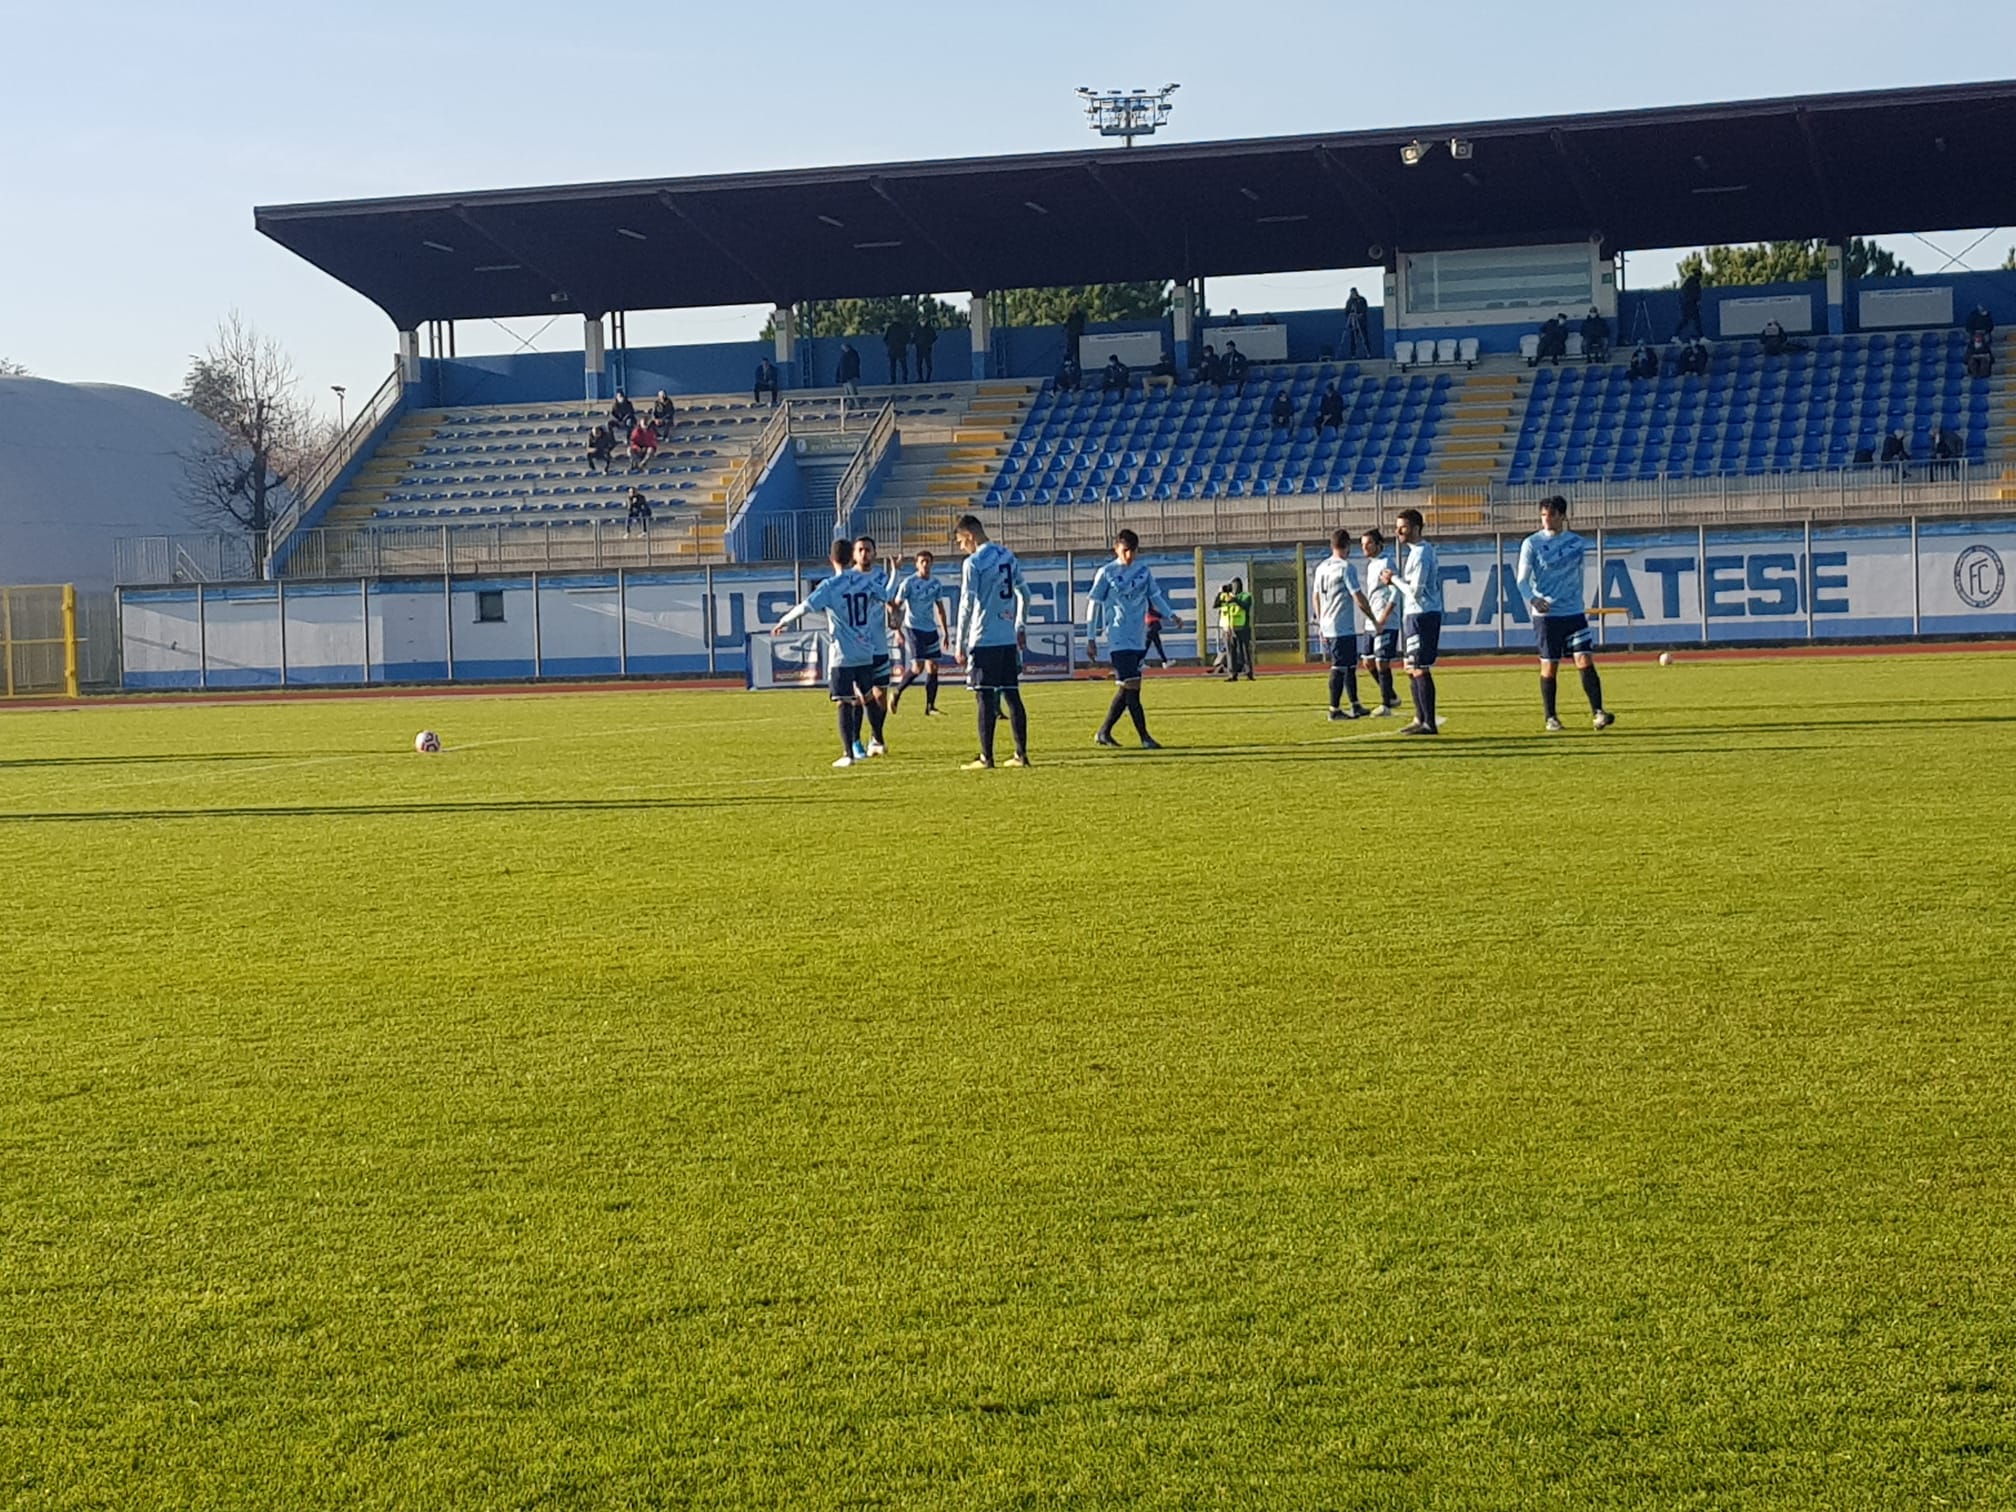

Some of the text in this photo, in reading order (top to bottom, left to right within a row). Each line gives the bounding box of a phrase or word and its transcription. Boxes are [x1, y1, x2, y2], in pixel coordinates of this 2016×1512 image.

[998, 562, 1013, 600] 3
[1436, 551, 1849, 626] CAATESE
[1969, 557, 1990, 597] FC
[842, 592, 868, 627] 10
